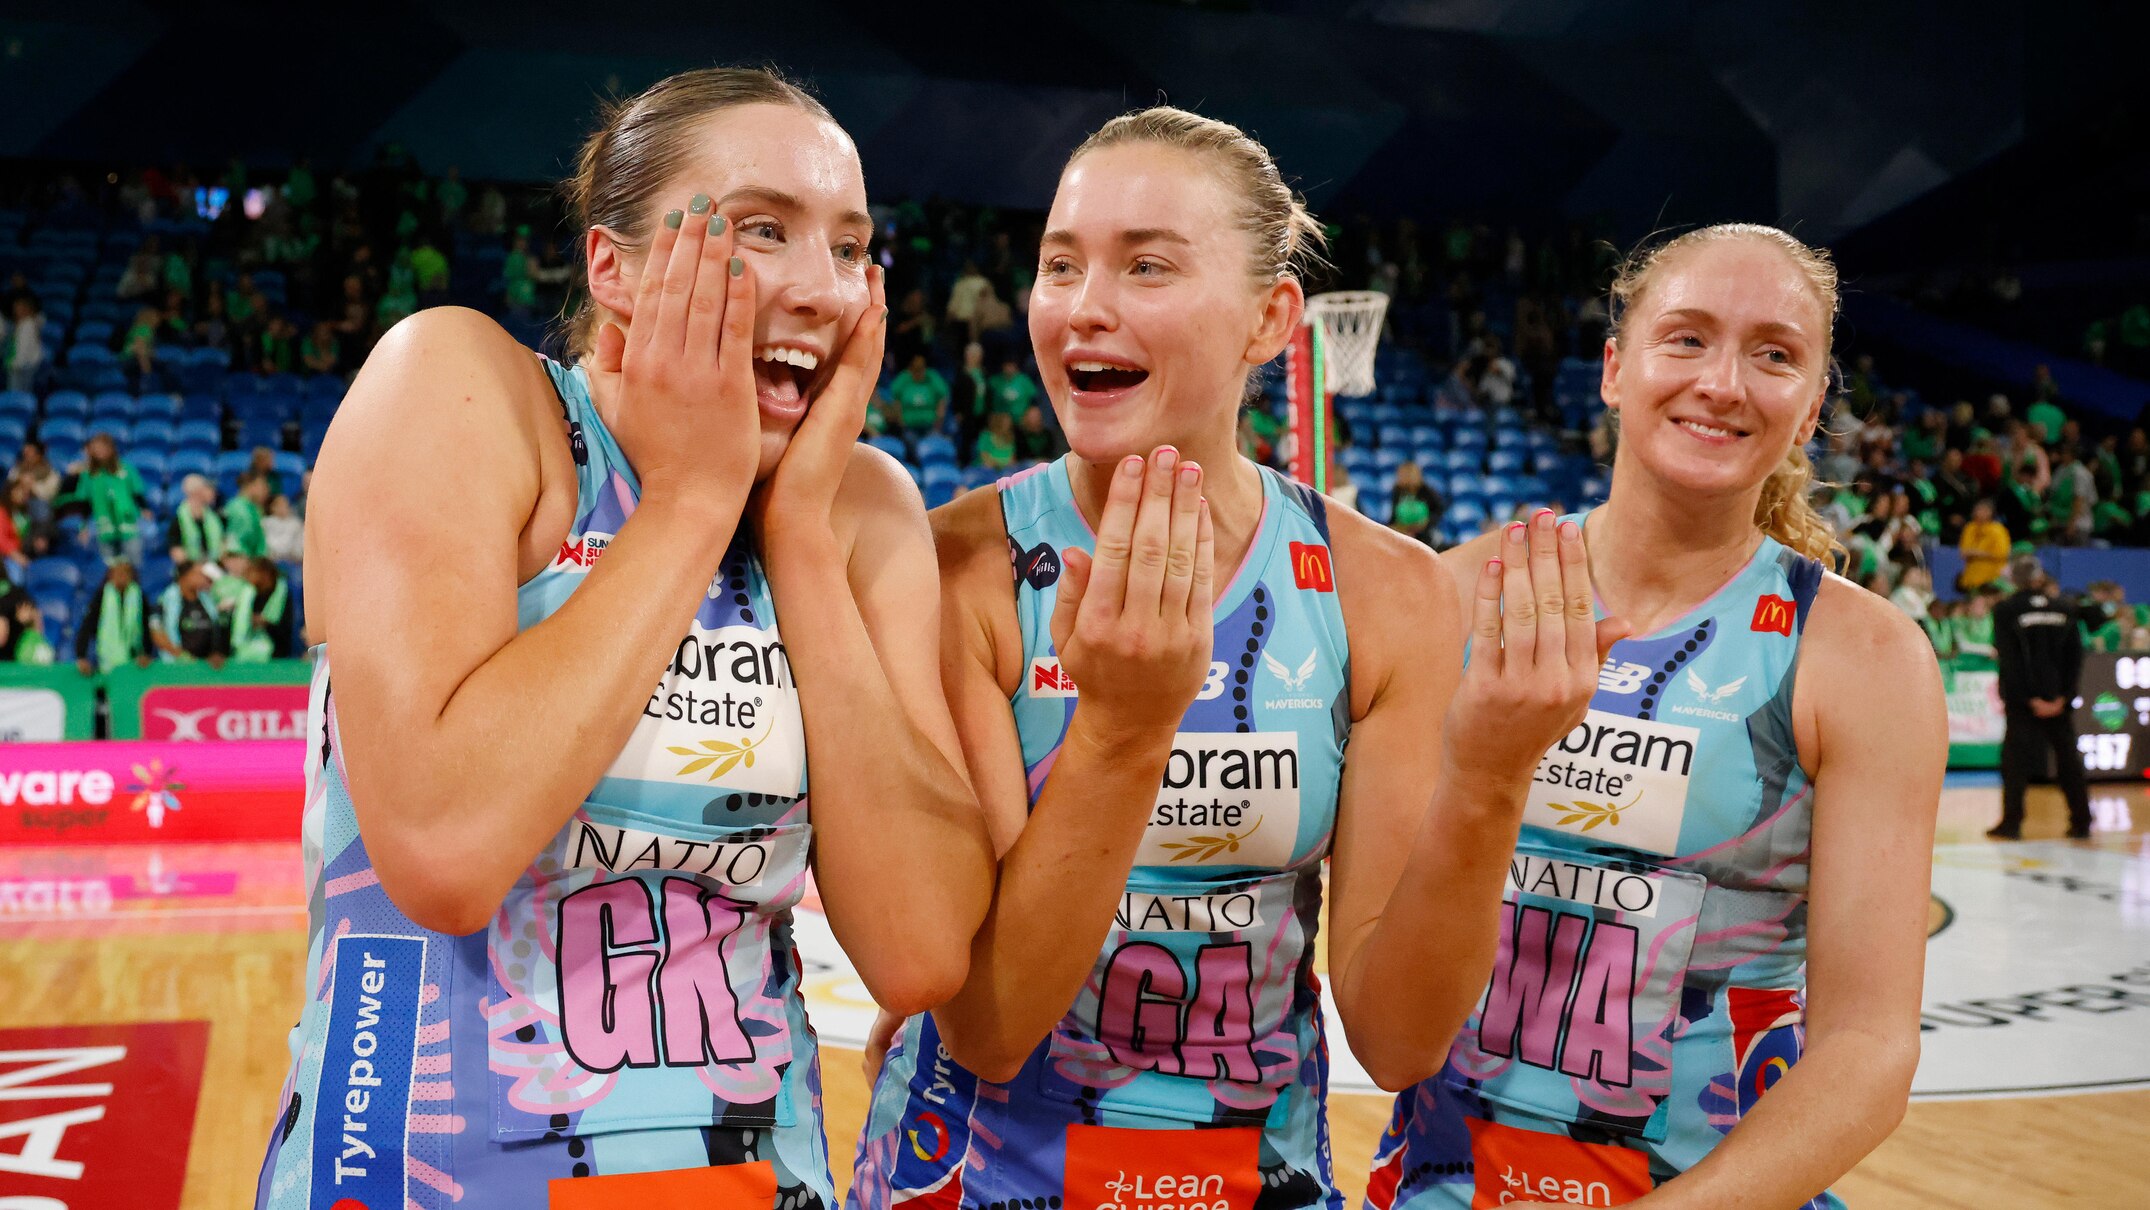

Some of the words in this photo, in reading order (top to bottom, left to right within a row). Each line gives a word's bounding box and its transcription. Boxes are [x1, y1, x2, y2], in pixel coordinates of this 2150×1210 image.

[1036, 562, 1056, 577] Hills
[665, 635, 797, 689] bram
[1265, 698, 1323, 710] MAVERICKS
[1671, 704, 1739, 723] MAVERICKS
[1147, 798, 1250, 827] state®
[573, 820, 767, 885] NATIO
[1510, 855, 1654, 912] NATIO
[1115, 893, 1255, 931] NATIO
[555, 876, 758, 1075] GK
[1478, 900, 1639, 1088] WA
[1096, 940, 1263, 1085] GA
[335, 952, 386, 1185] Tyrepower
[1135, 1174, 1224, 1199] Lean
[1522, 1171, 1612, 1207] Lean
